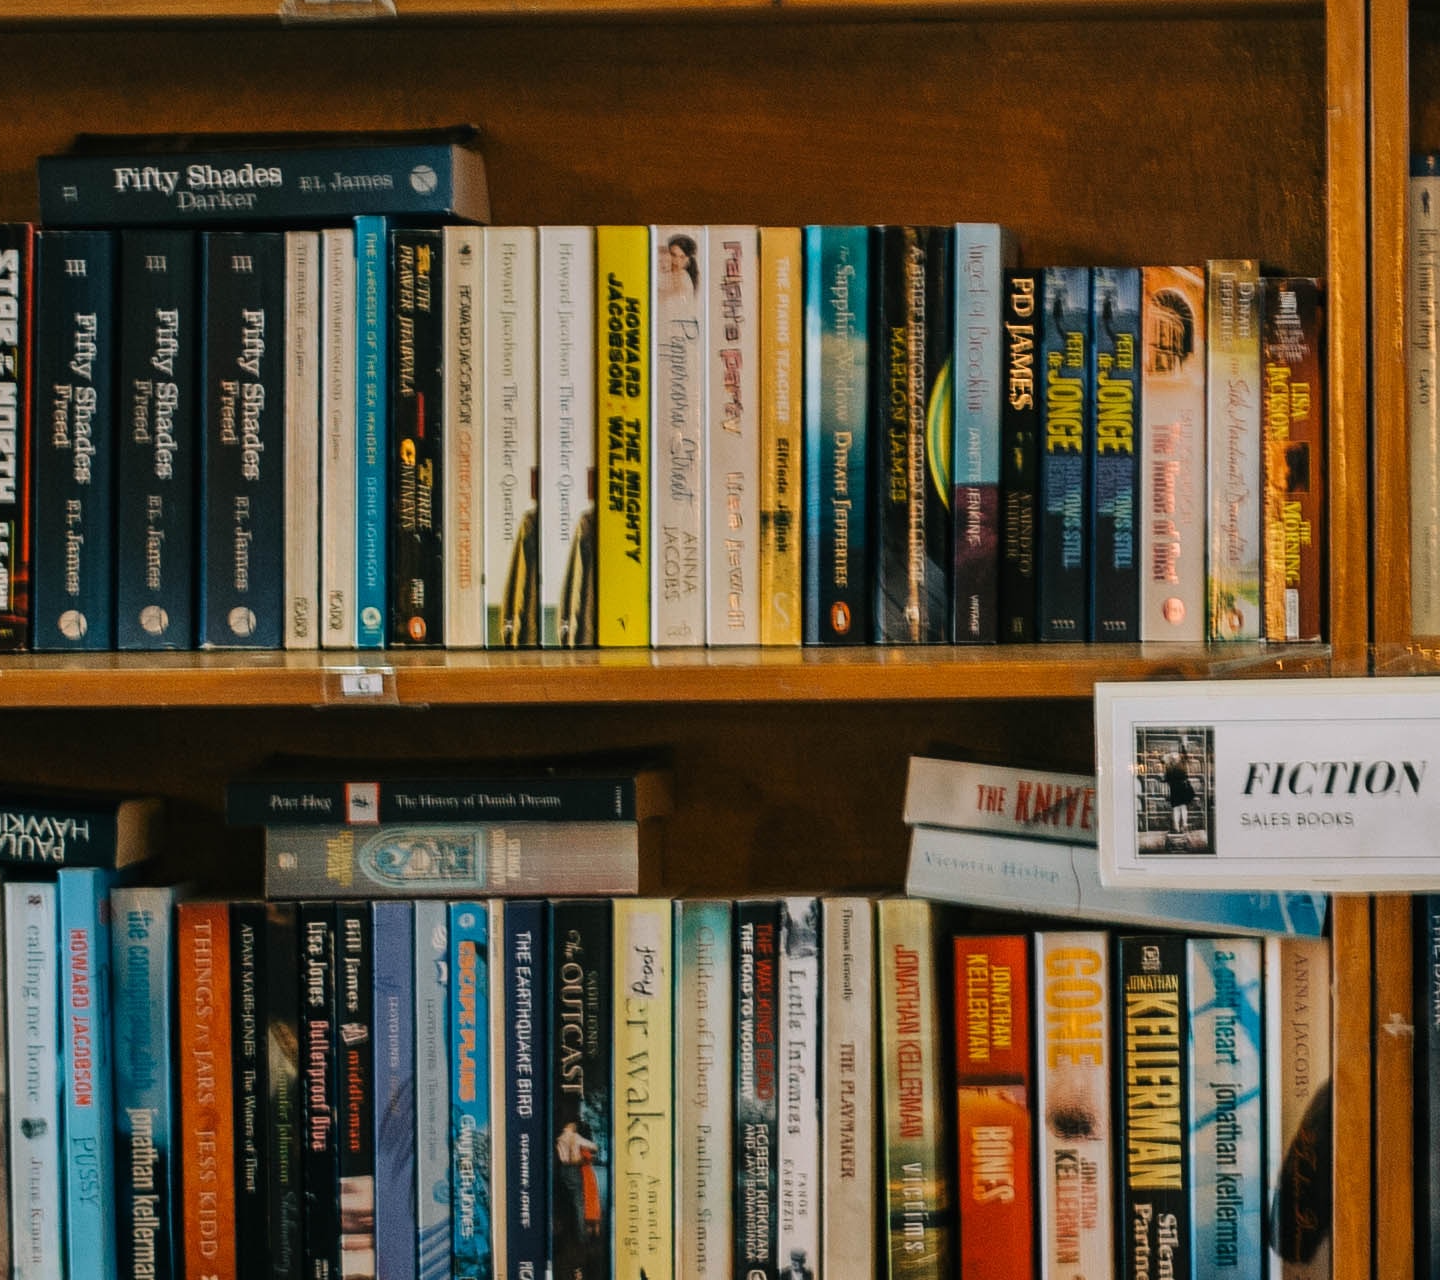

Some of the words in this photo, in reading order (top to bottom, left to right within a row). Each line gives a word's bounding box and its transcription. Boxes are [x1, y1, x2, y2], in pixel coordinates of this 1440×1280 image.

[113, 167, 180, 195] Fifty
[187, 165, 282, 190] Shades
[176, 190, 257, 211] Darker
[1011, 278, 1034, 316] PD
[240, 310, 264, 375] Fifty
[1007, 323, 1034, 410] JAMES
[220, 380, 239, 444] Freed
[242, 382, 266, 480] Shades
[1242, 762, 1427, 795] FICTION
[1241, 813, 1293, 826] SALES
[1298, 813, 1354, 826] BOOKS
[966, 954, 988, 1060] KELLERMAN
[991, 965, 1010, 1047] JONATHAN
[1046, 948, 1103, 1071] GONE
[1127, 992, 1182, 1190] KELLERMAN
[126, 1108, 154, 1189] jonathan
[972, 1125, 1013, 1203] BONES
